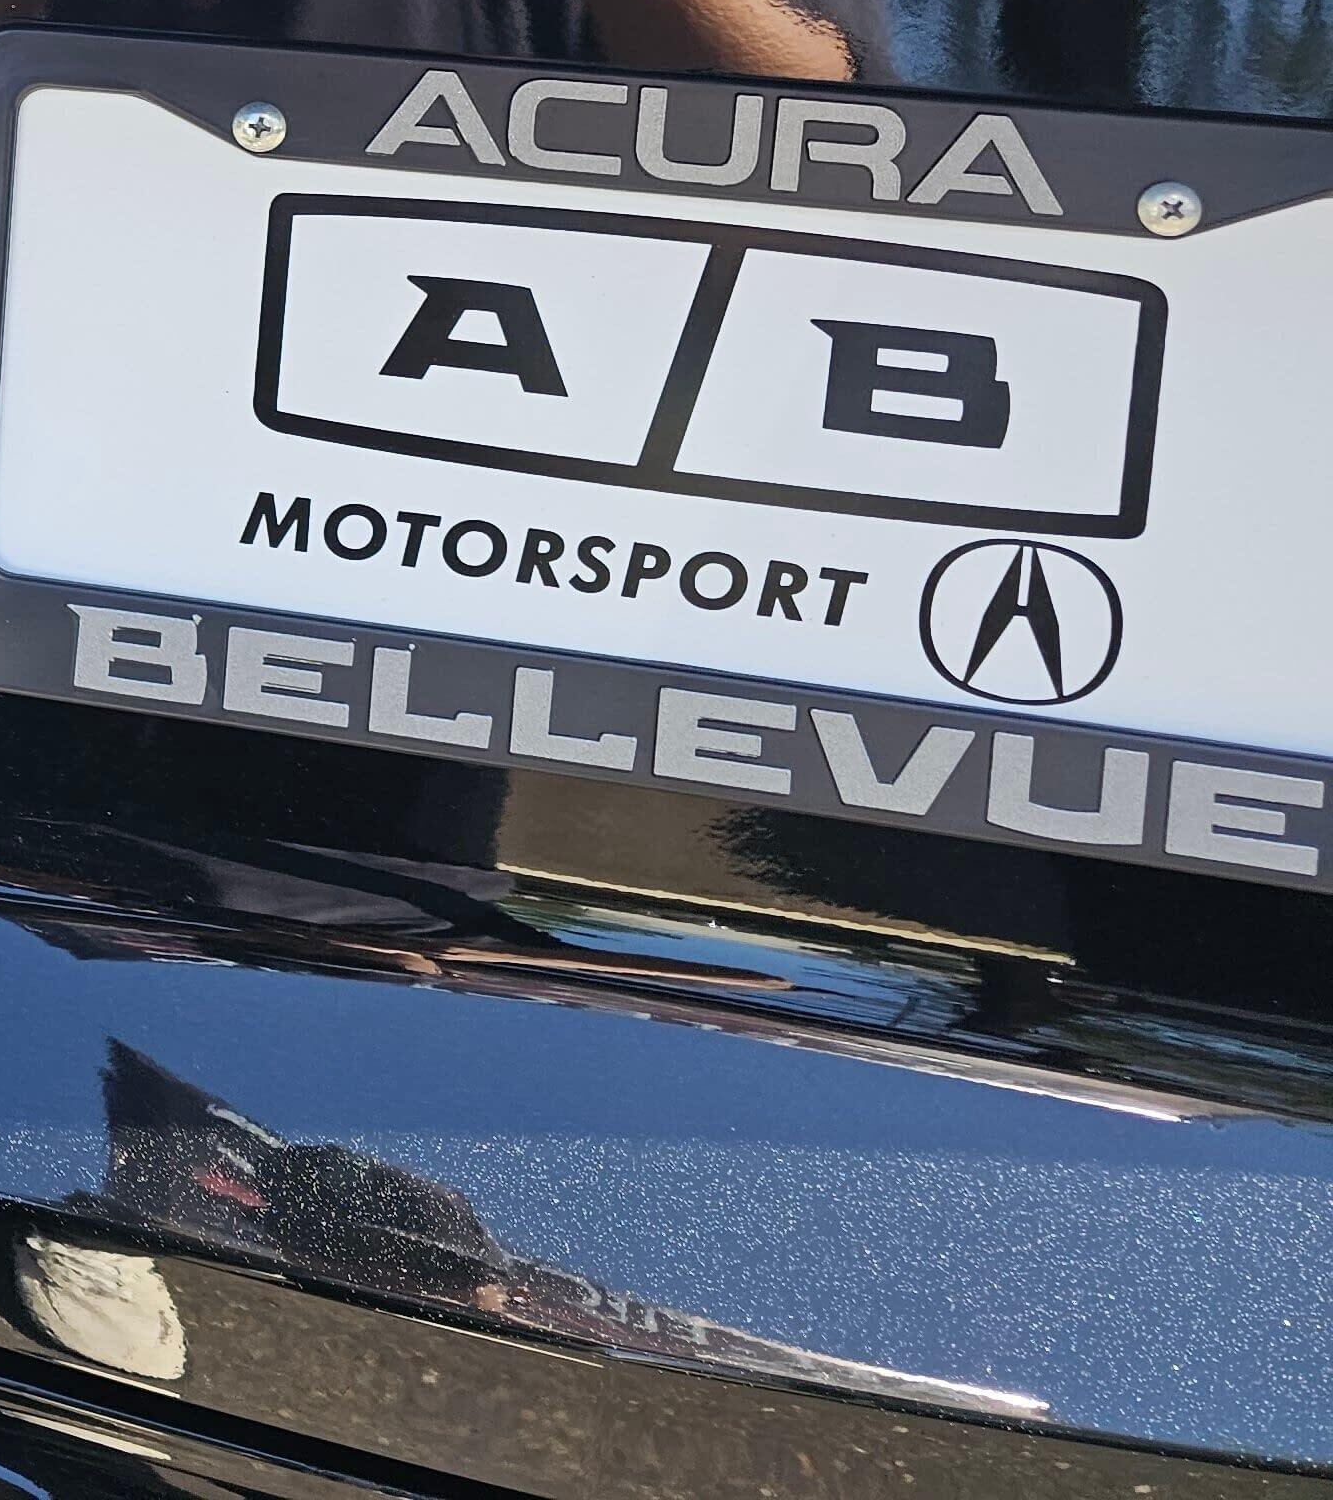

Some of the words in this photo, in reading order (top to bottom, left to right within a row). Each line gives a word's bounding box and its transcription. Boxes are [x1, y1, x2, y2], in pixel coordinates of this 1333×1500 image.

[364, 69, 1064, 216] ACURA
[379, 274, 569, 398] A
[809, 318, 1012, 448] B
[240, 492, 869, 628] MOTORSPORT
[66, 603, 1327, 878] BELLEVUE
